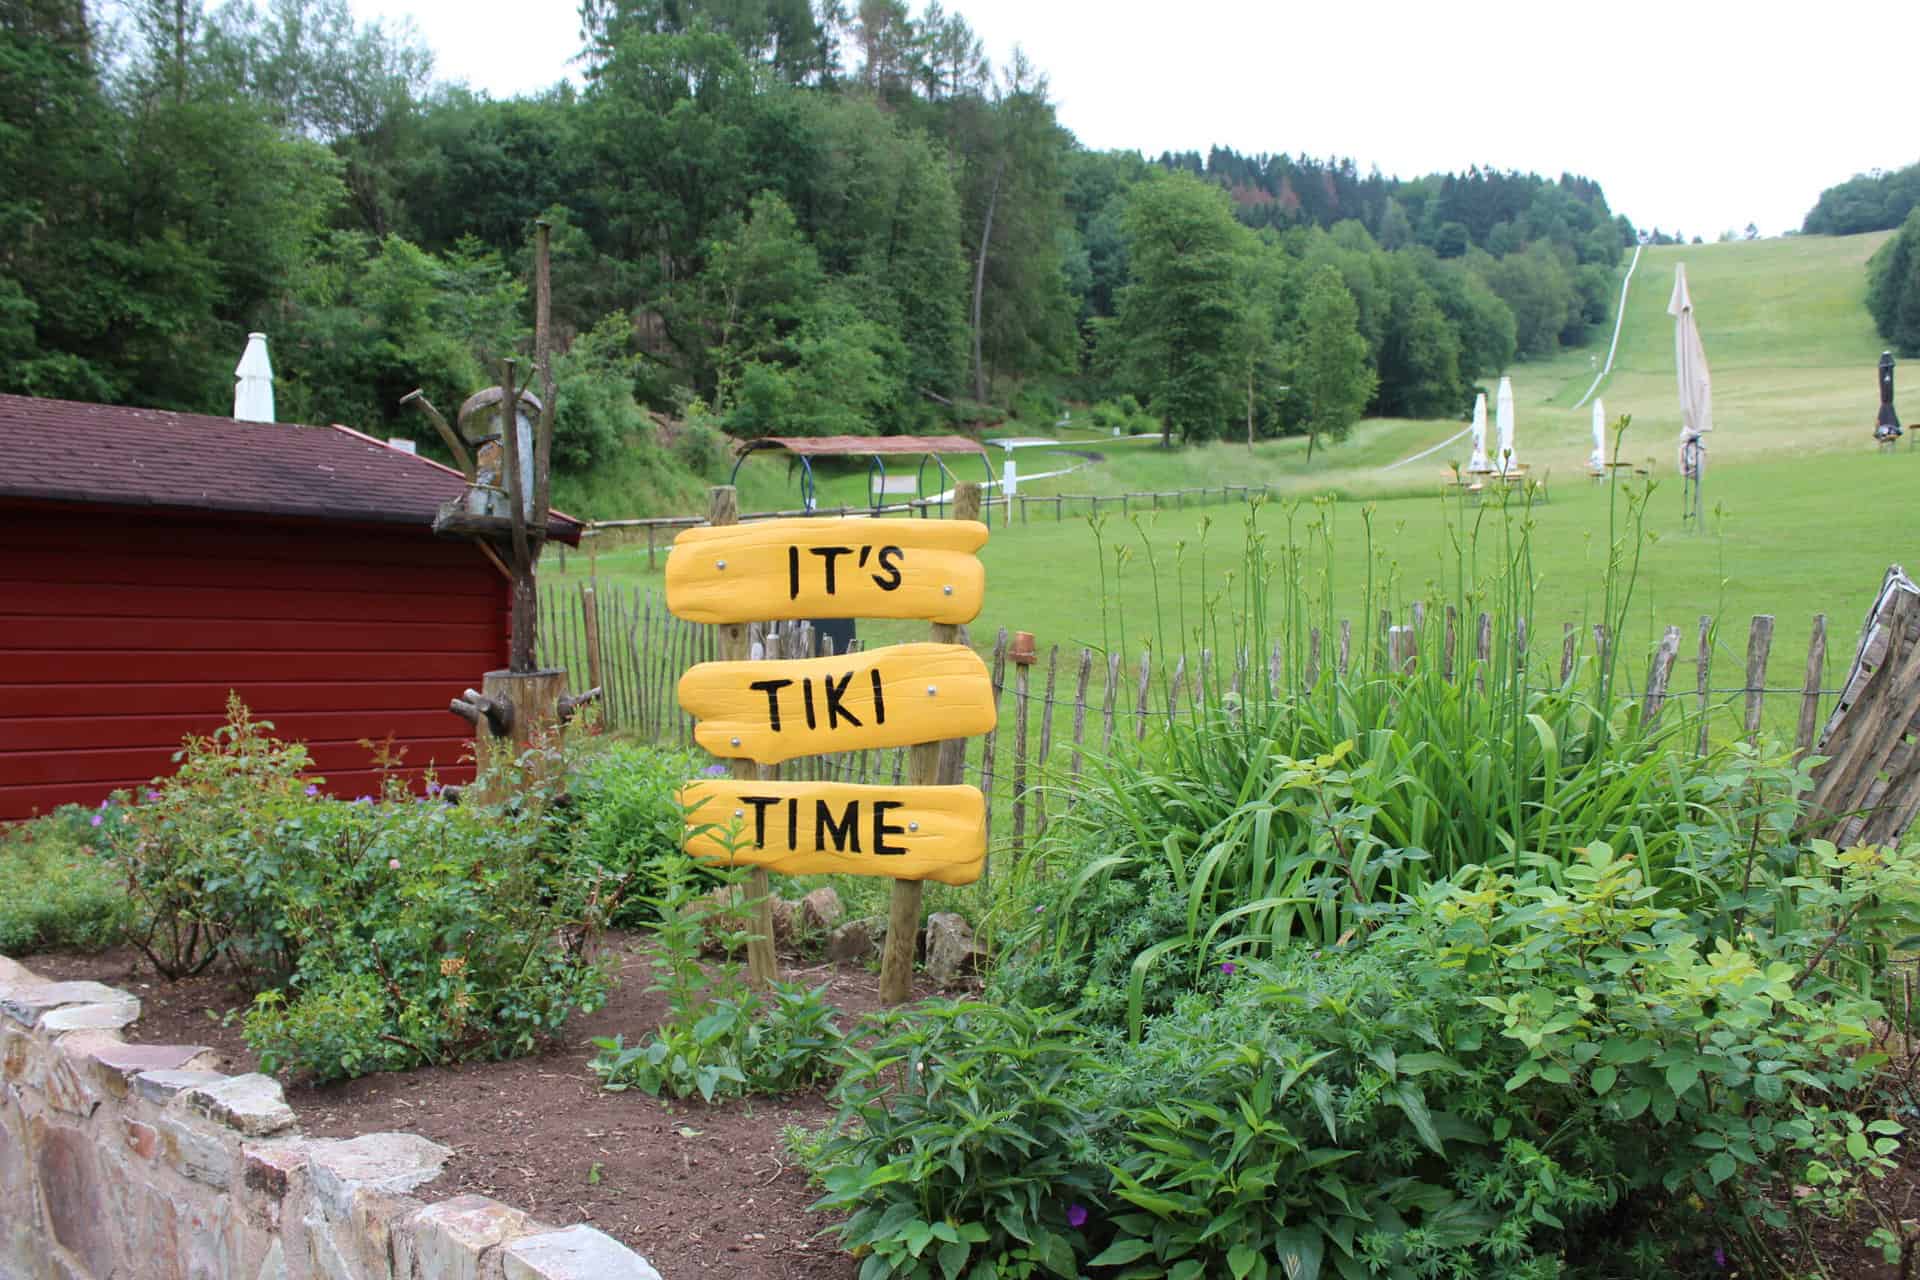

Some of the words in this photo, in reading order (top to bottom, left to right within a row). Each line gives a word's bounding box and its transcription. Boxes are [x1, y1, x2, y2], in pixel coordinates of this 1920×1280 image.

[788, 545, 904, 600] IT'S
[749, 668, 886, 733] TIKI
[737, 796, 910, 855] TIME
